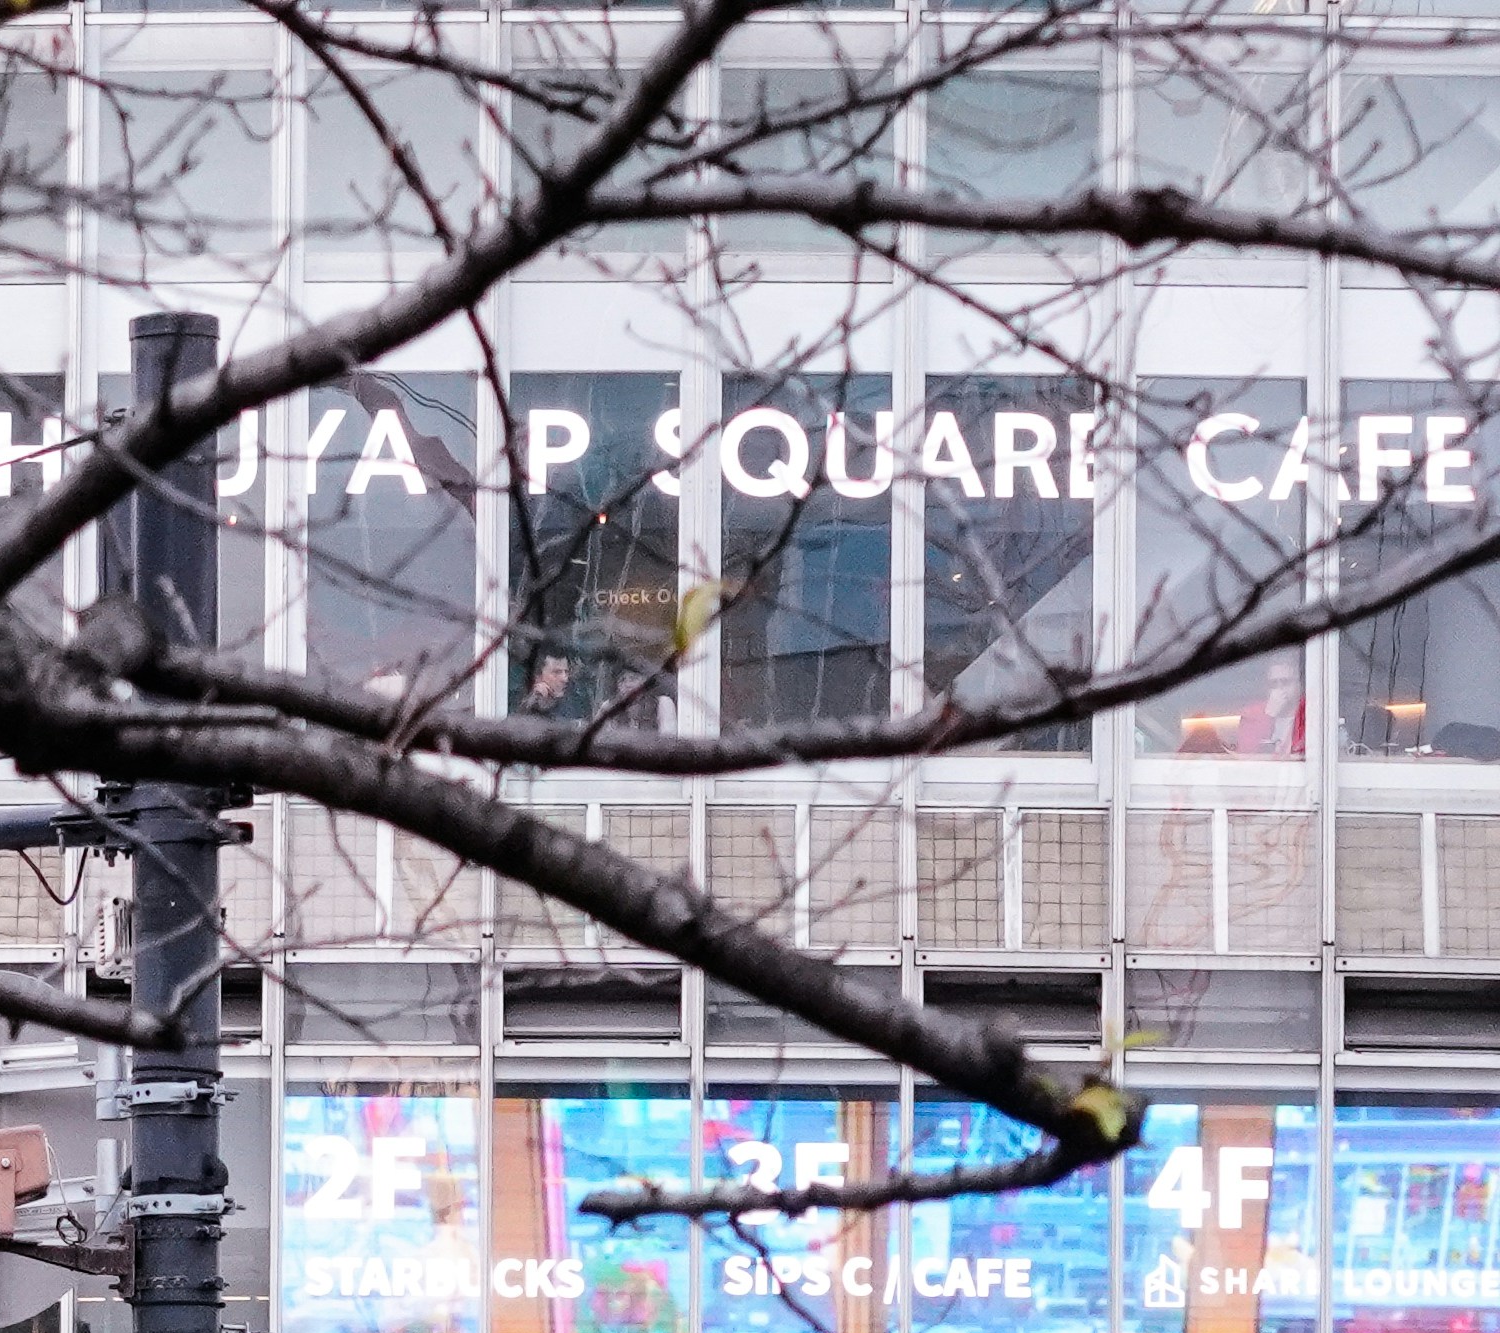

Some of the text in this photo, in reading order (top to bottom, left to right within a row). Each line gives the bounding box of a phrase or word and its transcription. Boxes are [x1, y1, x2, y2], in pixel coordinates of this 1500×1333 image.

[303, 1135, 427, 1219] 2F
[727, 1141, 850, 1225] 3F
[1148, 1146, 1274, 1229] 4F
[913, 1257, 1032, 1298] CAFE
